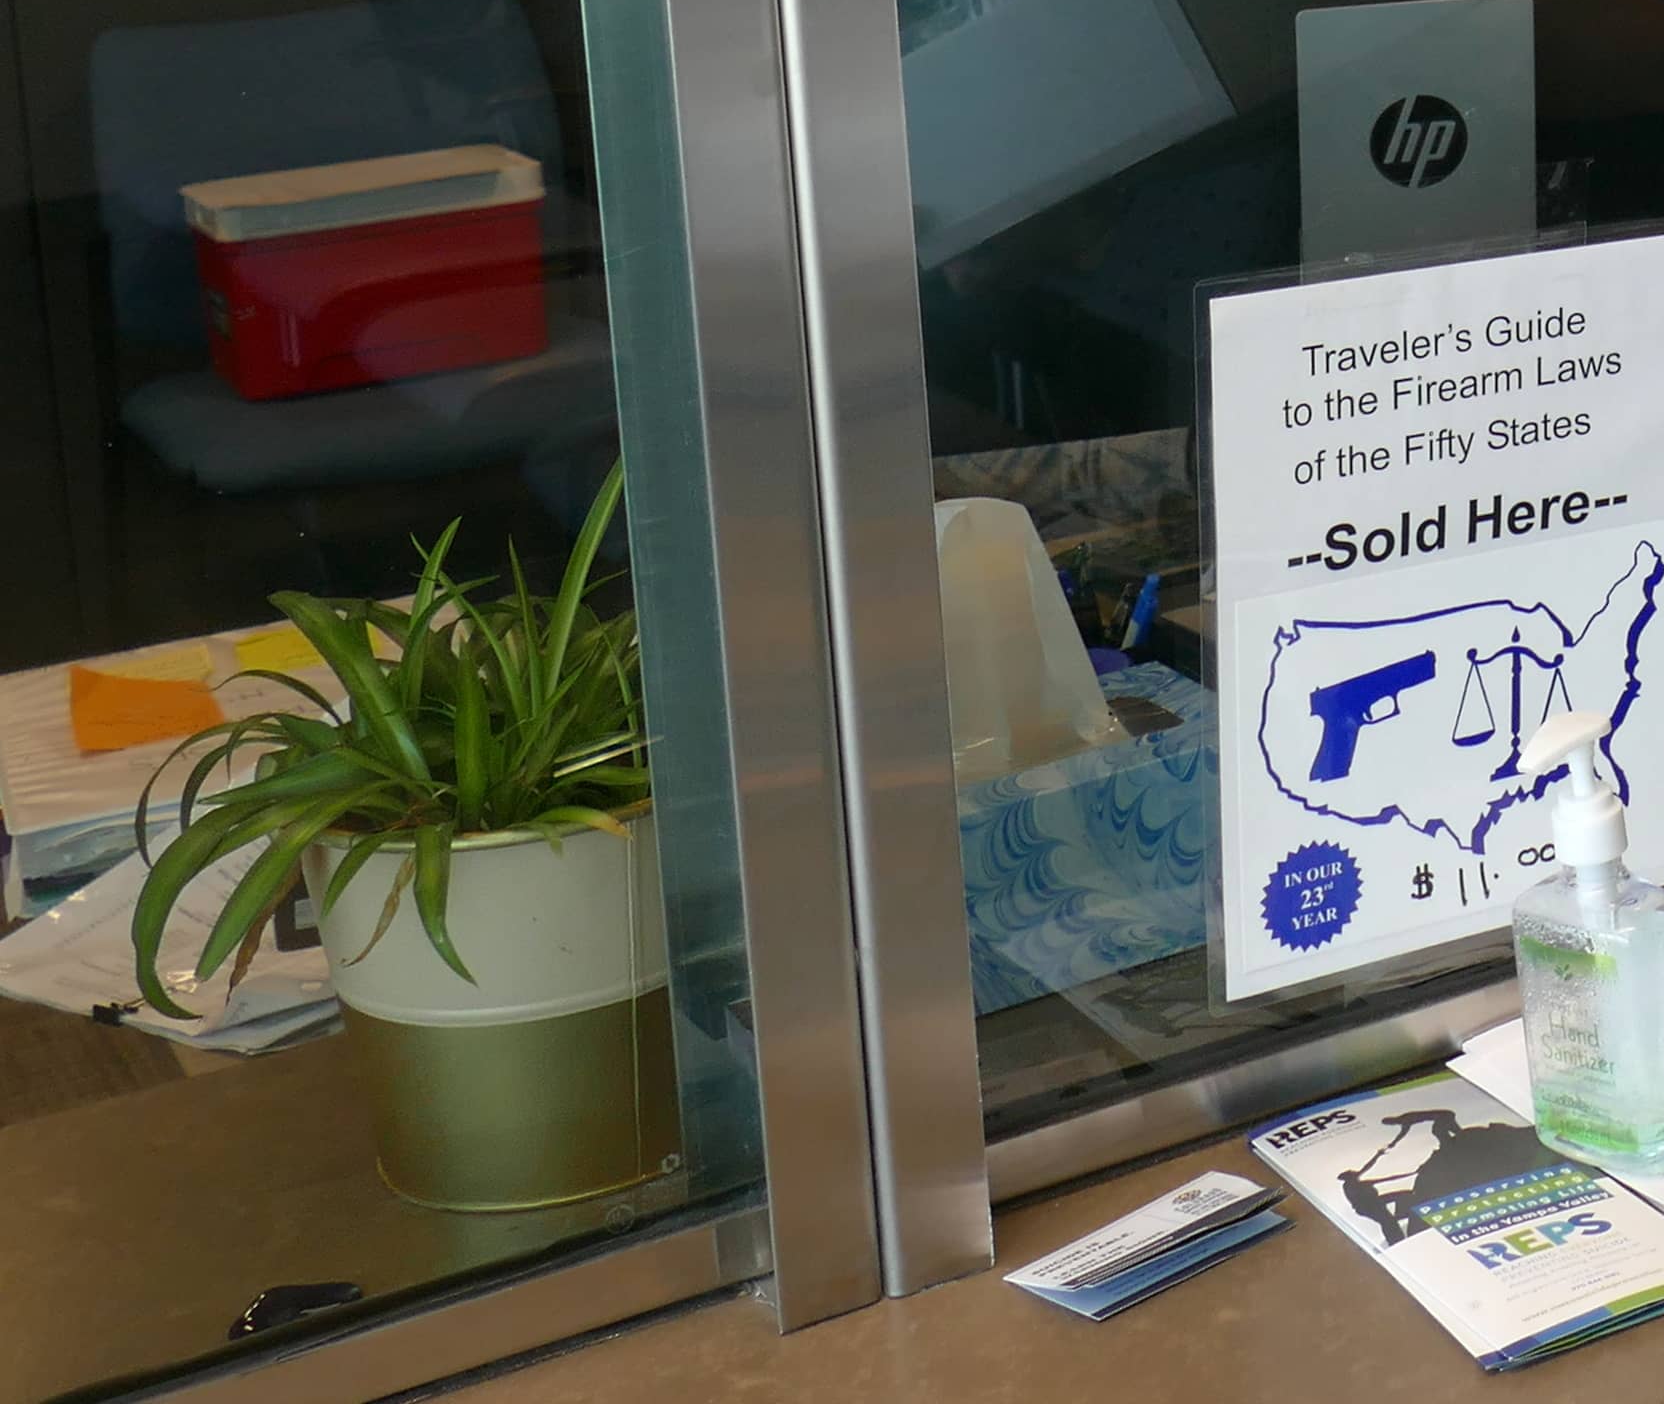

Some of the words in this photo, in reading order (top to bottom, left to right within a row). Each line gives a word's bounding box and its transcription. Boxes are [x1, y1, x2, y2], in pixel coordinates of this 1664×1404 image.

[1383, 95, 1457, 188] hp
[1302, 323, 1473, 376] Traveler's
[1485, 307, 1587, 347] Guide
[1282, 398, 1313, 428] to
[1324, 388, 1379, 421] the
[1392, 367, 1523, 410] Firearm
[1536, 351, 1623, 387] Laws
[1294, 449, 1327, 485] of
[1336, 445, 1390, 478] the
[1405, 428, 1475, 466] Fifty
[1487, 412, 1592, 450] States
[1287, 504, 1447, 571] --Sold
[1468, 490, 1629, 545] Here--
[1284, 872, 1304, 890] IN
[1306, 860, 1344, 884] OUR
[1300, 880, 1335, 910] 23rd
[1291, 907, 1339, 931] YEAR
[1549, 1011, 1600, 1048] Hand
[1541, 1032, 1616, 1076] Sanitizer
[1266, 1109, 1357, 1149] REPS
[1471, 1221, 1499, 1238] the
[1500, 1205, 1559, 1230] Yampa
[1559, 1192, 1610, 1210] Valley
[1467, 1211, 1613, 1271] REPS
